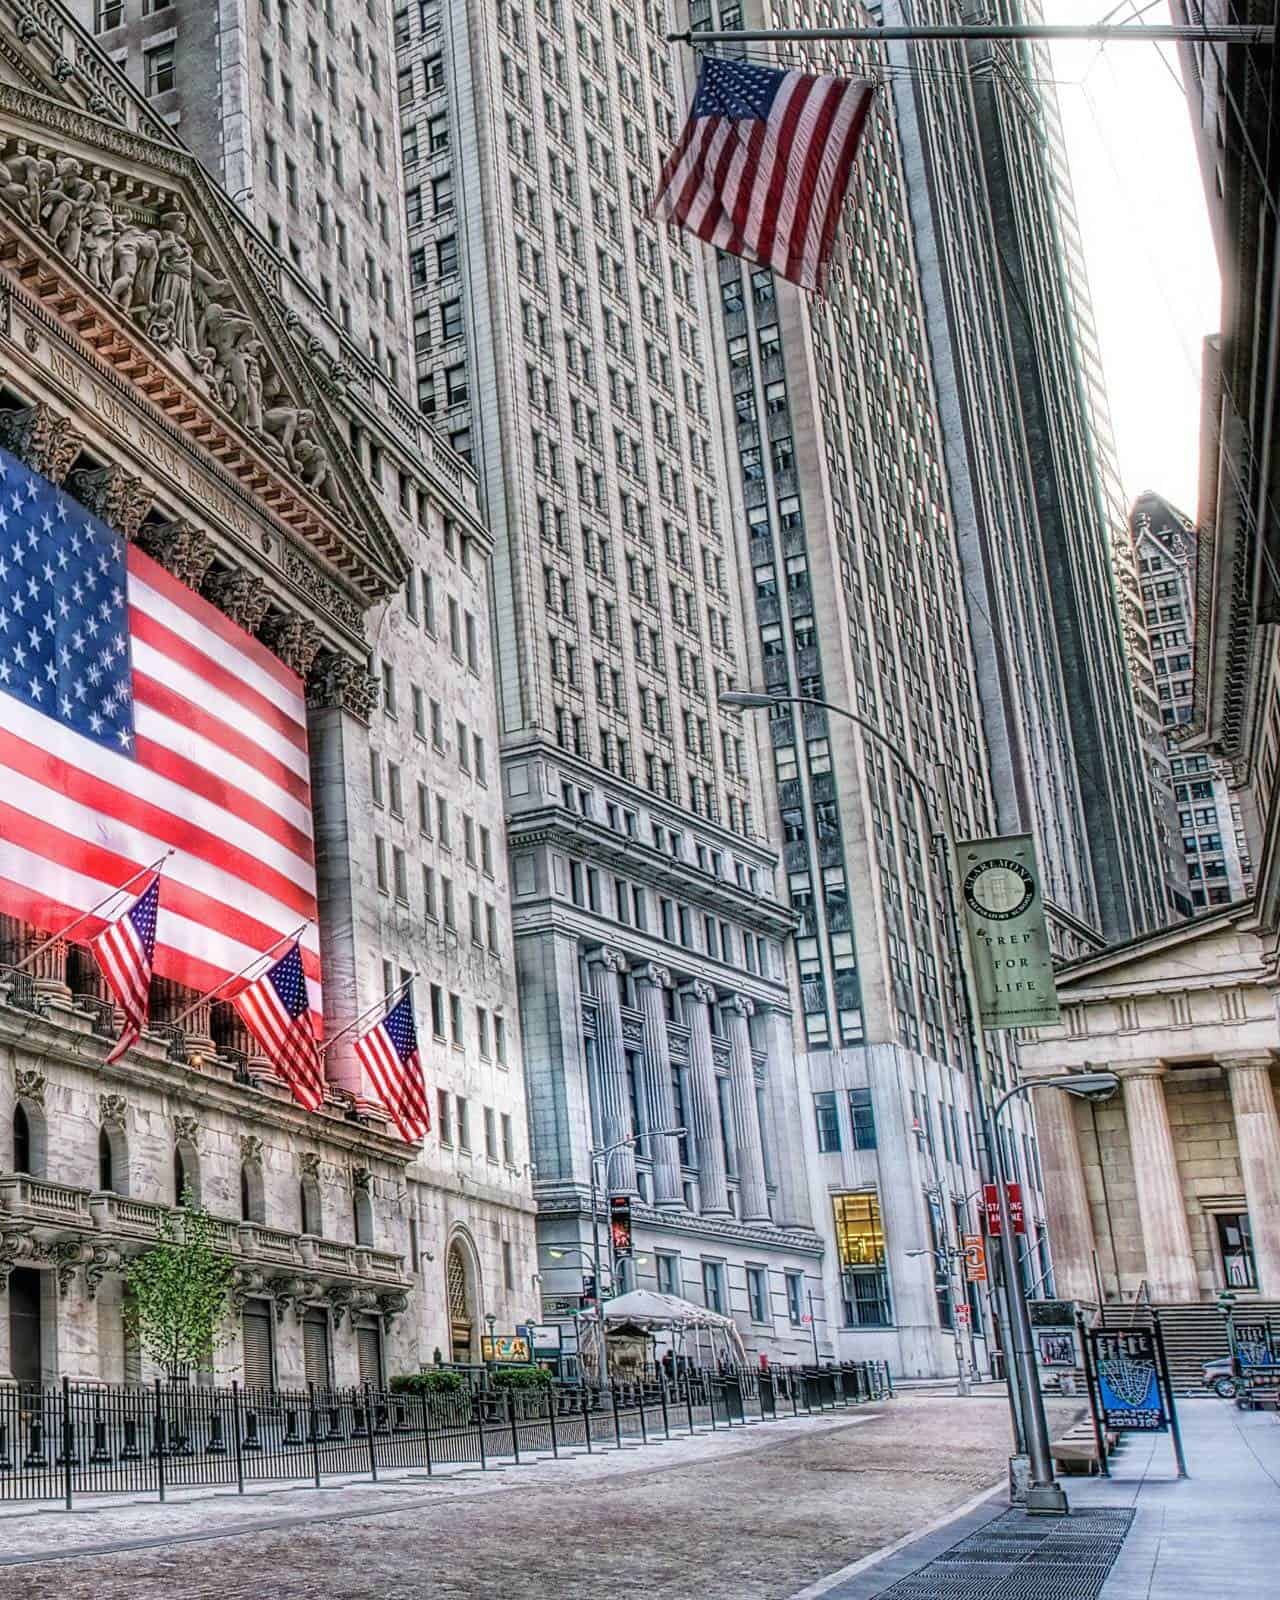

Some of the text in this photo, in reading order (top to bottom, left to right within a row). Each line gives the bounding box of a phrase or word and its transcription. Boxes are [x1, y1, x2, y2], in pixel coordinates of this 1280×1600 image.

[49, 347, 253, 540] NEW YORK STOCK EXCHANGE
[985, 934, 1031, 946] PREP
[994, 958, 1029, 969] FOR
[995, 981, 1036, 993] LIFE
